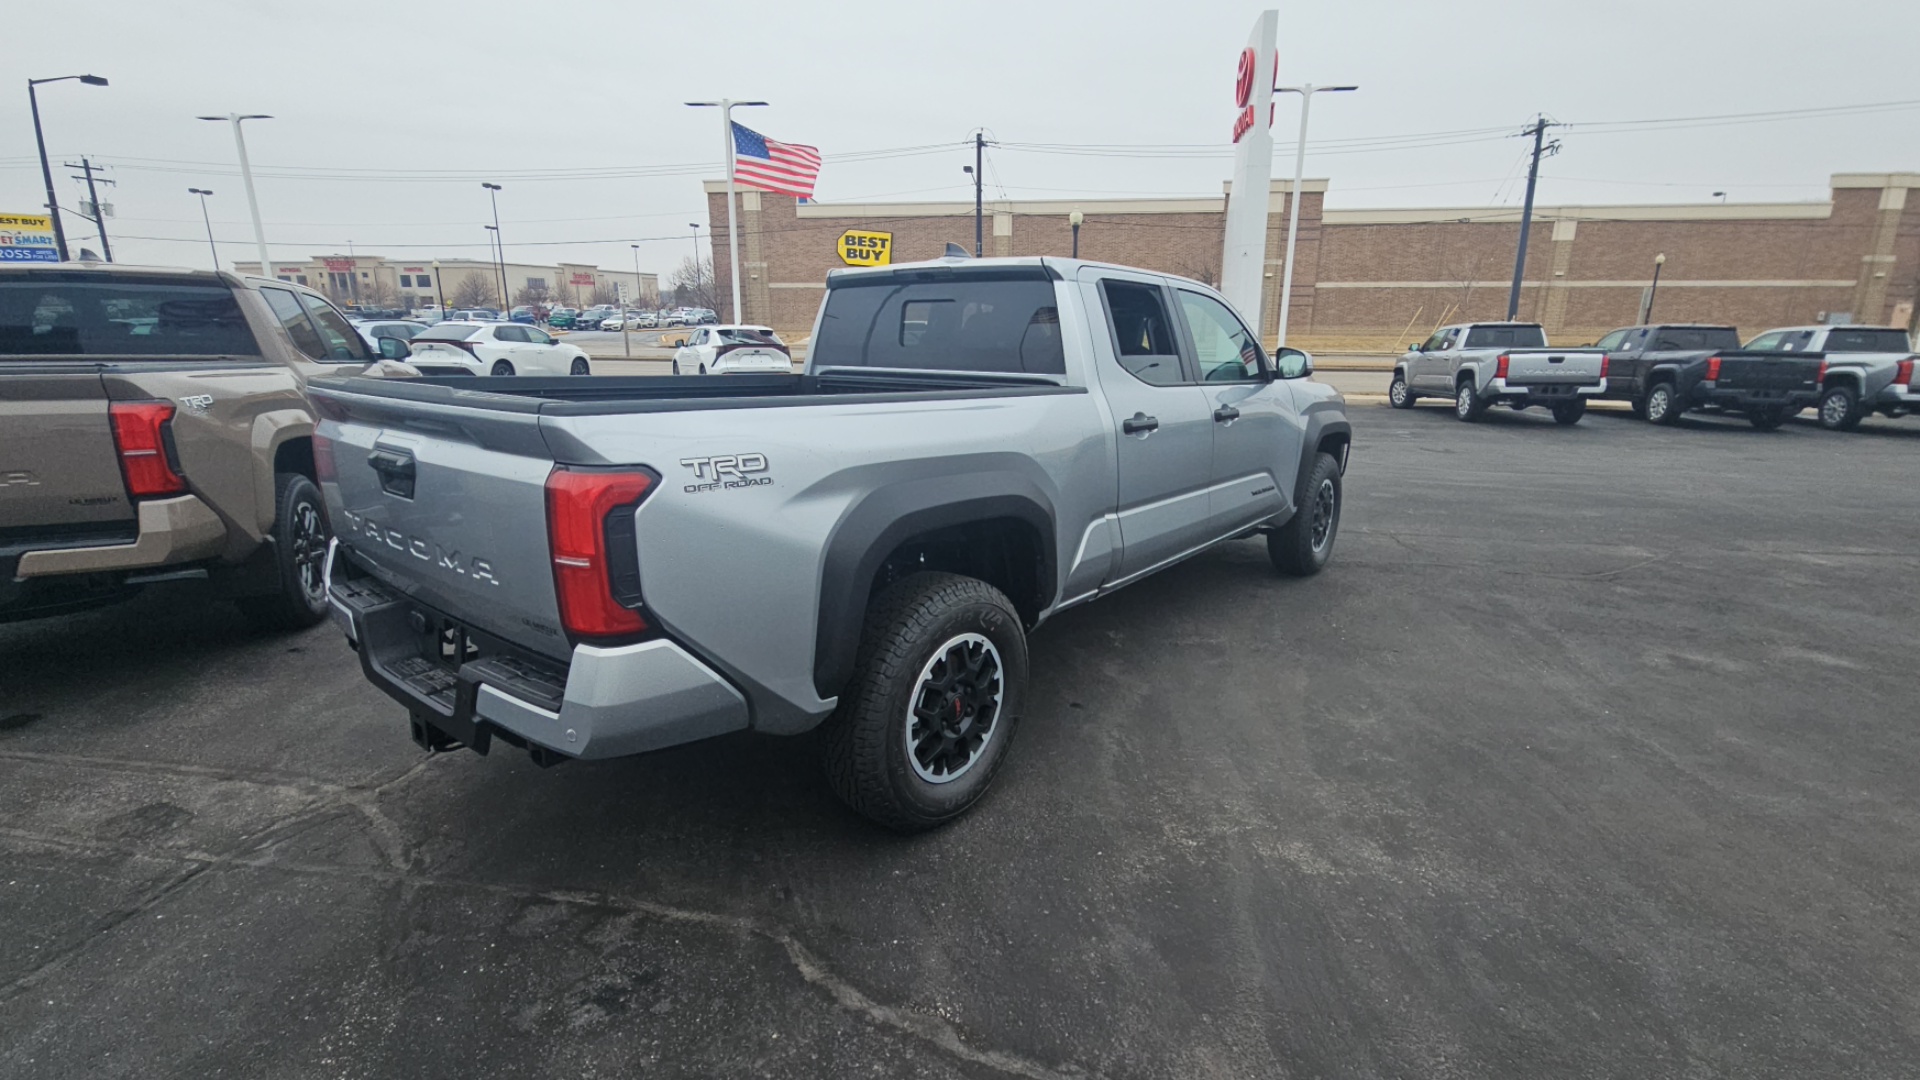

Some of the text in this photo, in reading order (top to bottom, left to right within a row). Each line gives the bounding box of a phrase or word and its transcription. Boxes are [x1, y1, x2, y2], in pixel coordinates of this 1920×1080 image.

[845, 235, 889, 249] BEST
[846, 248, 884, 261] BUY
[178, 394, 214, 409] TRD
[680, 452, 769, 482] TRD
[684, 477, 774, 493] OFF ROAD
[344, 510, 500, 587] TACOMA
